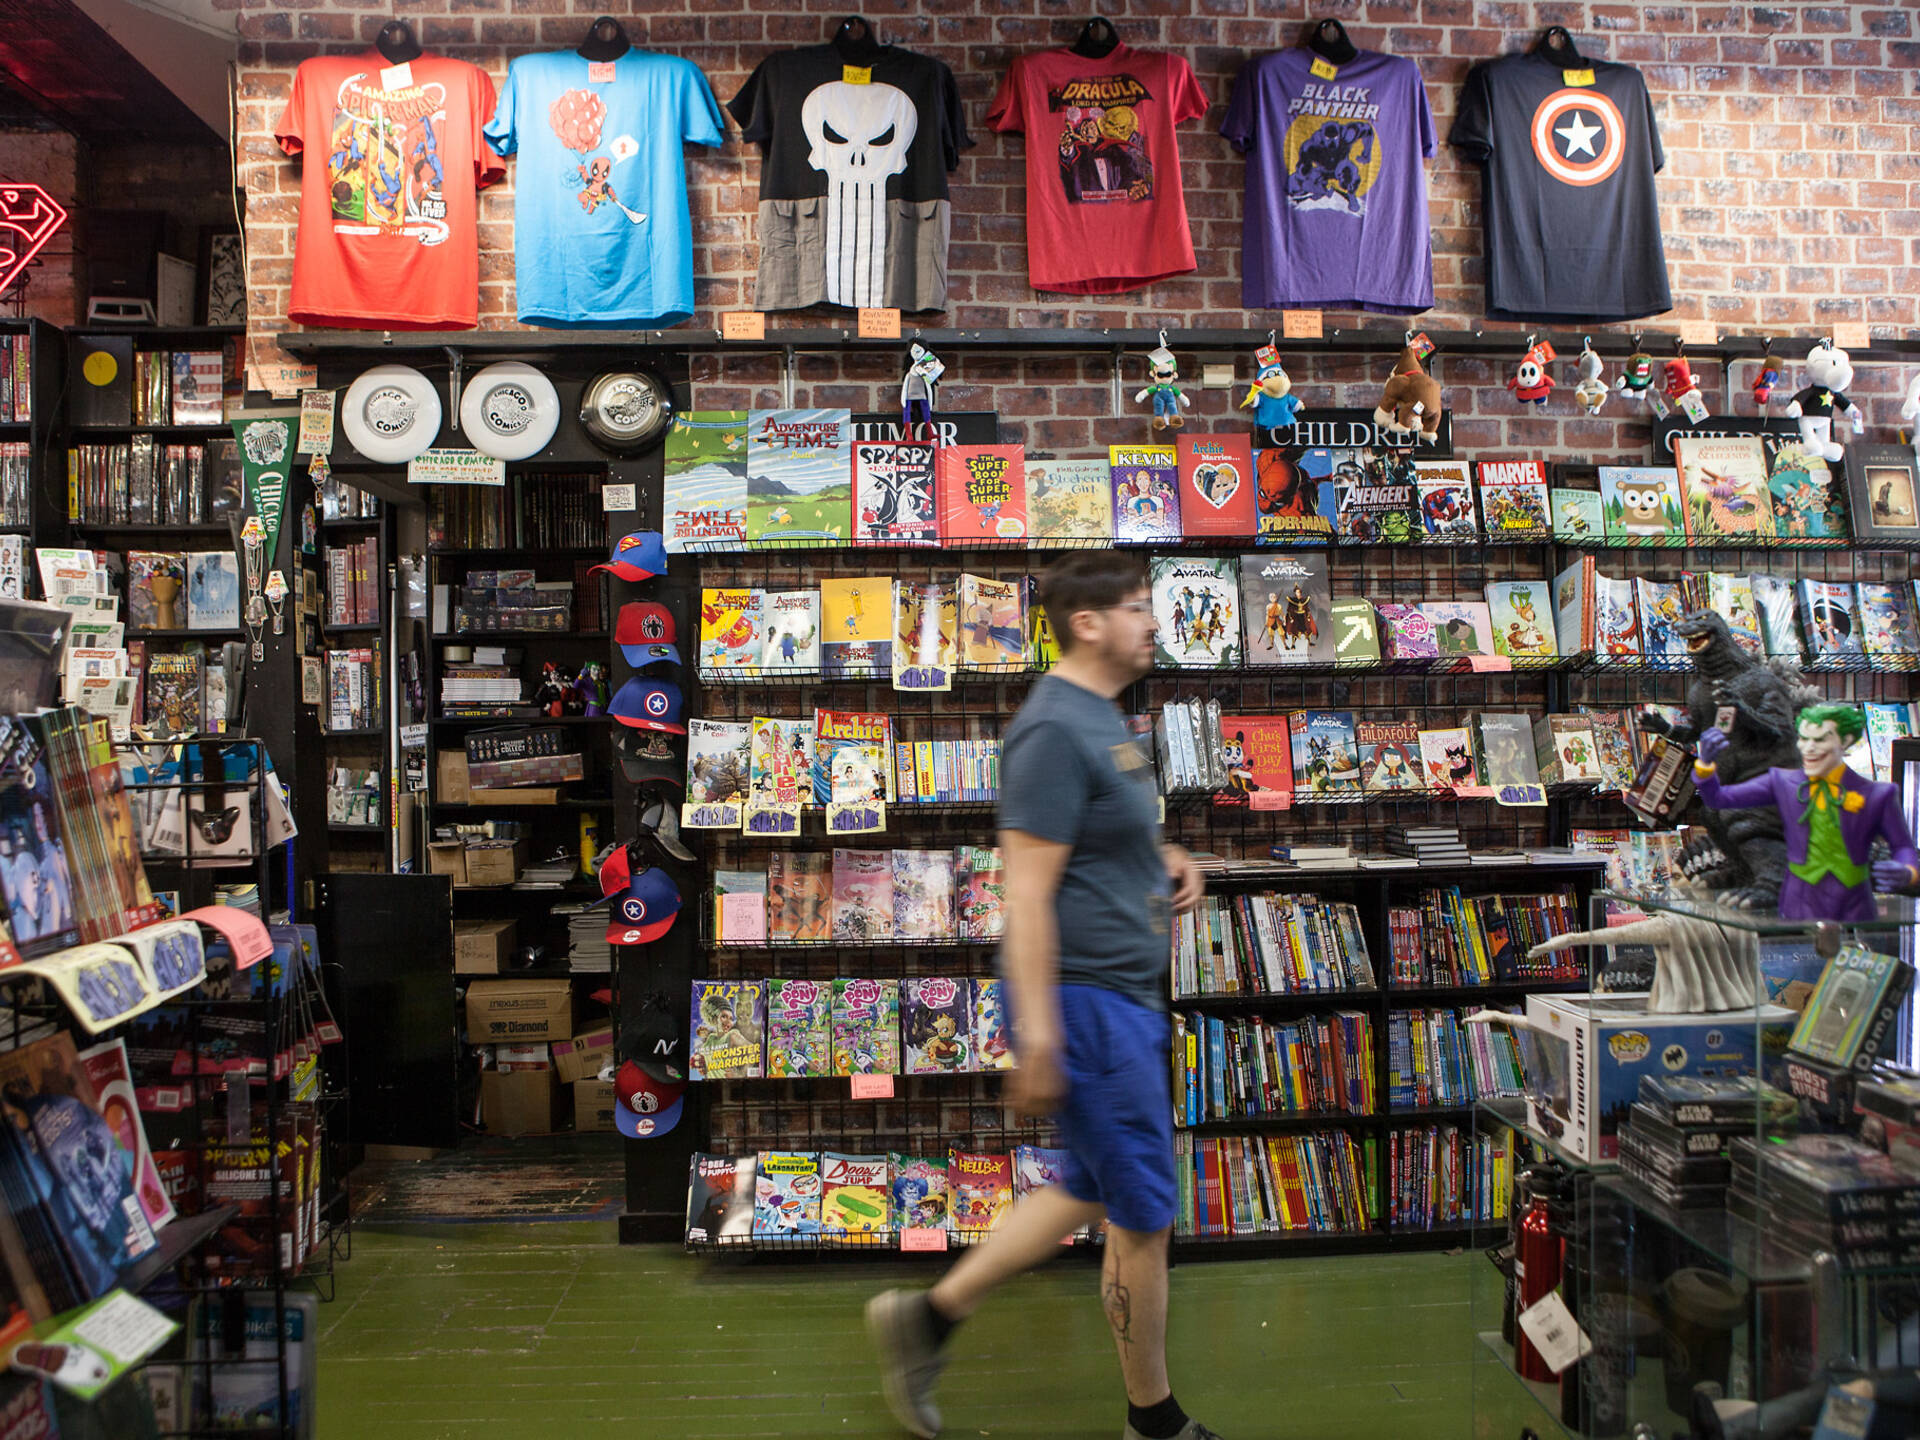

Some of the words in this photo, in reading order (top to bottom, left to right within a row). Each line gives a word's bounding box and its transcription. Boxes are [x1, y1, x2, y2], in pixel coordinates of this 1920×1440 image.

[363, 86, 425, 102] AMAZING
[1062, 80, 1144, 99] DRACULA
[1302, 83, 1370, 102] BLACK
[1288, 98, 1379, 120] PANTHER
[761, 416, 840, 434] ADVENTURE
[776, 433, 840, 449] TIME
[1192, 441, 1225, 455] Archie
[415, 455, 454, 464] CHICAGO
[457, 455, 496, 465] COMICS
[860, 447, 897, 465] SPY
[896, 446, 933, 465] SPY
[1118, 453, 1173, 466] KEVIN
[969, 460, 1010, 471] SUPER
[974, 471, 1006, 480] BOOK
[1483, 462, 1543, 484] MARVEL
[980, 478, 1001, 486] FOR
[969, 484, 1014, 496] SUPER-
[258, 471, 284, 532] CHICAGO
[972, 494, 1012, 504] HEROES
[1340, 483, 1413, 512] AVENGERS
[675, 510, 738, 527] TIME
[1259, 515, 1333, 533] SPIDER-MAN
[1172, 568, 1224, 580] AVATAR
[1261, 566, 1315, 577] AVATAR
[334, 555, 347, 614] HUMBUG
[716, 591, 761, 602] ADVENTURE
[776, 595, 811, 604] ADVENTURE
[727, 600, 760, 611] TIME
[1402, 620, 1428, 634] PONY
[838, 644, 875, 653] ADVENTURE
[160, 655, 197, 664] INFINITY
[149, 663, 198, 674] GAUNTLET
[821, 713, 883, 739] Archie
[1311, 719, 1348, 728] AVATAR
[1252, 728, 1282, 743] Chu's
[1360, 728, 1418, 741] HILDAFOLK
[1250, 741, 1281, 754] First
[1254, 754, 1283, 768] Day
[781, 986, 818, 1003] PONY
[843, 985, 881, 1003] PONY
[919, 984, 955, 1003] PONY
[508, 1020, 549, 1033] Diamond
[712, 1043, 761, 1060] MONSTER
[707, 1055, 761, 1071] MARRIAGE
[1575, 1026, 1586, 1132] BATMOBILE
[1788, 1063, 1829, 1086] GHOST
[1791, 1079, 1829, 1104] RIDER
[1676, 1111, 1713, 1122] WARS
[1681, 1105, 1710, 1114] STAR
[1690, 1134, 1718, 1142] STAR
[1687, 1140, 1720, 1152] WARS
[707, 1159, 725, 1168] BEE
[768, 1163, 815, 1173] LABORATORY
[826, 1159, 883, 1180] DOODLE
[958, 1158, 1004, 1175] HELLBOY
[216, 1169, 256, 1180] SILICONE
[842, 1175, 873, 1185] JUMP
